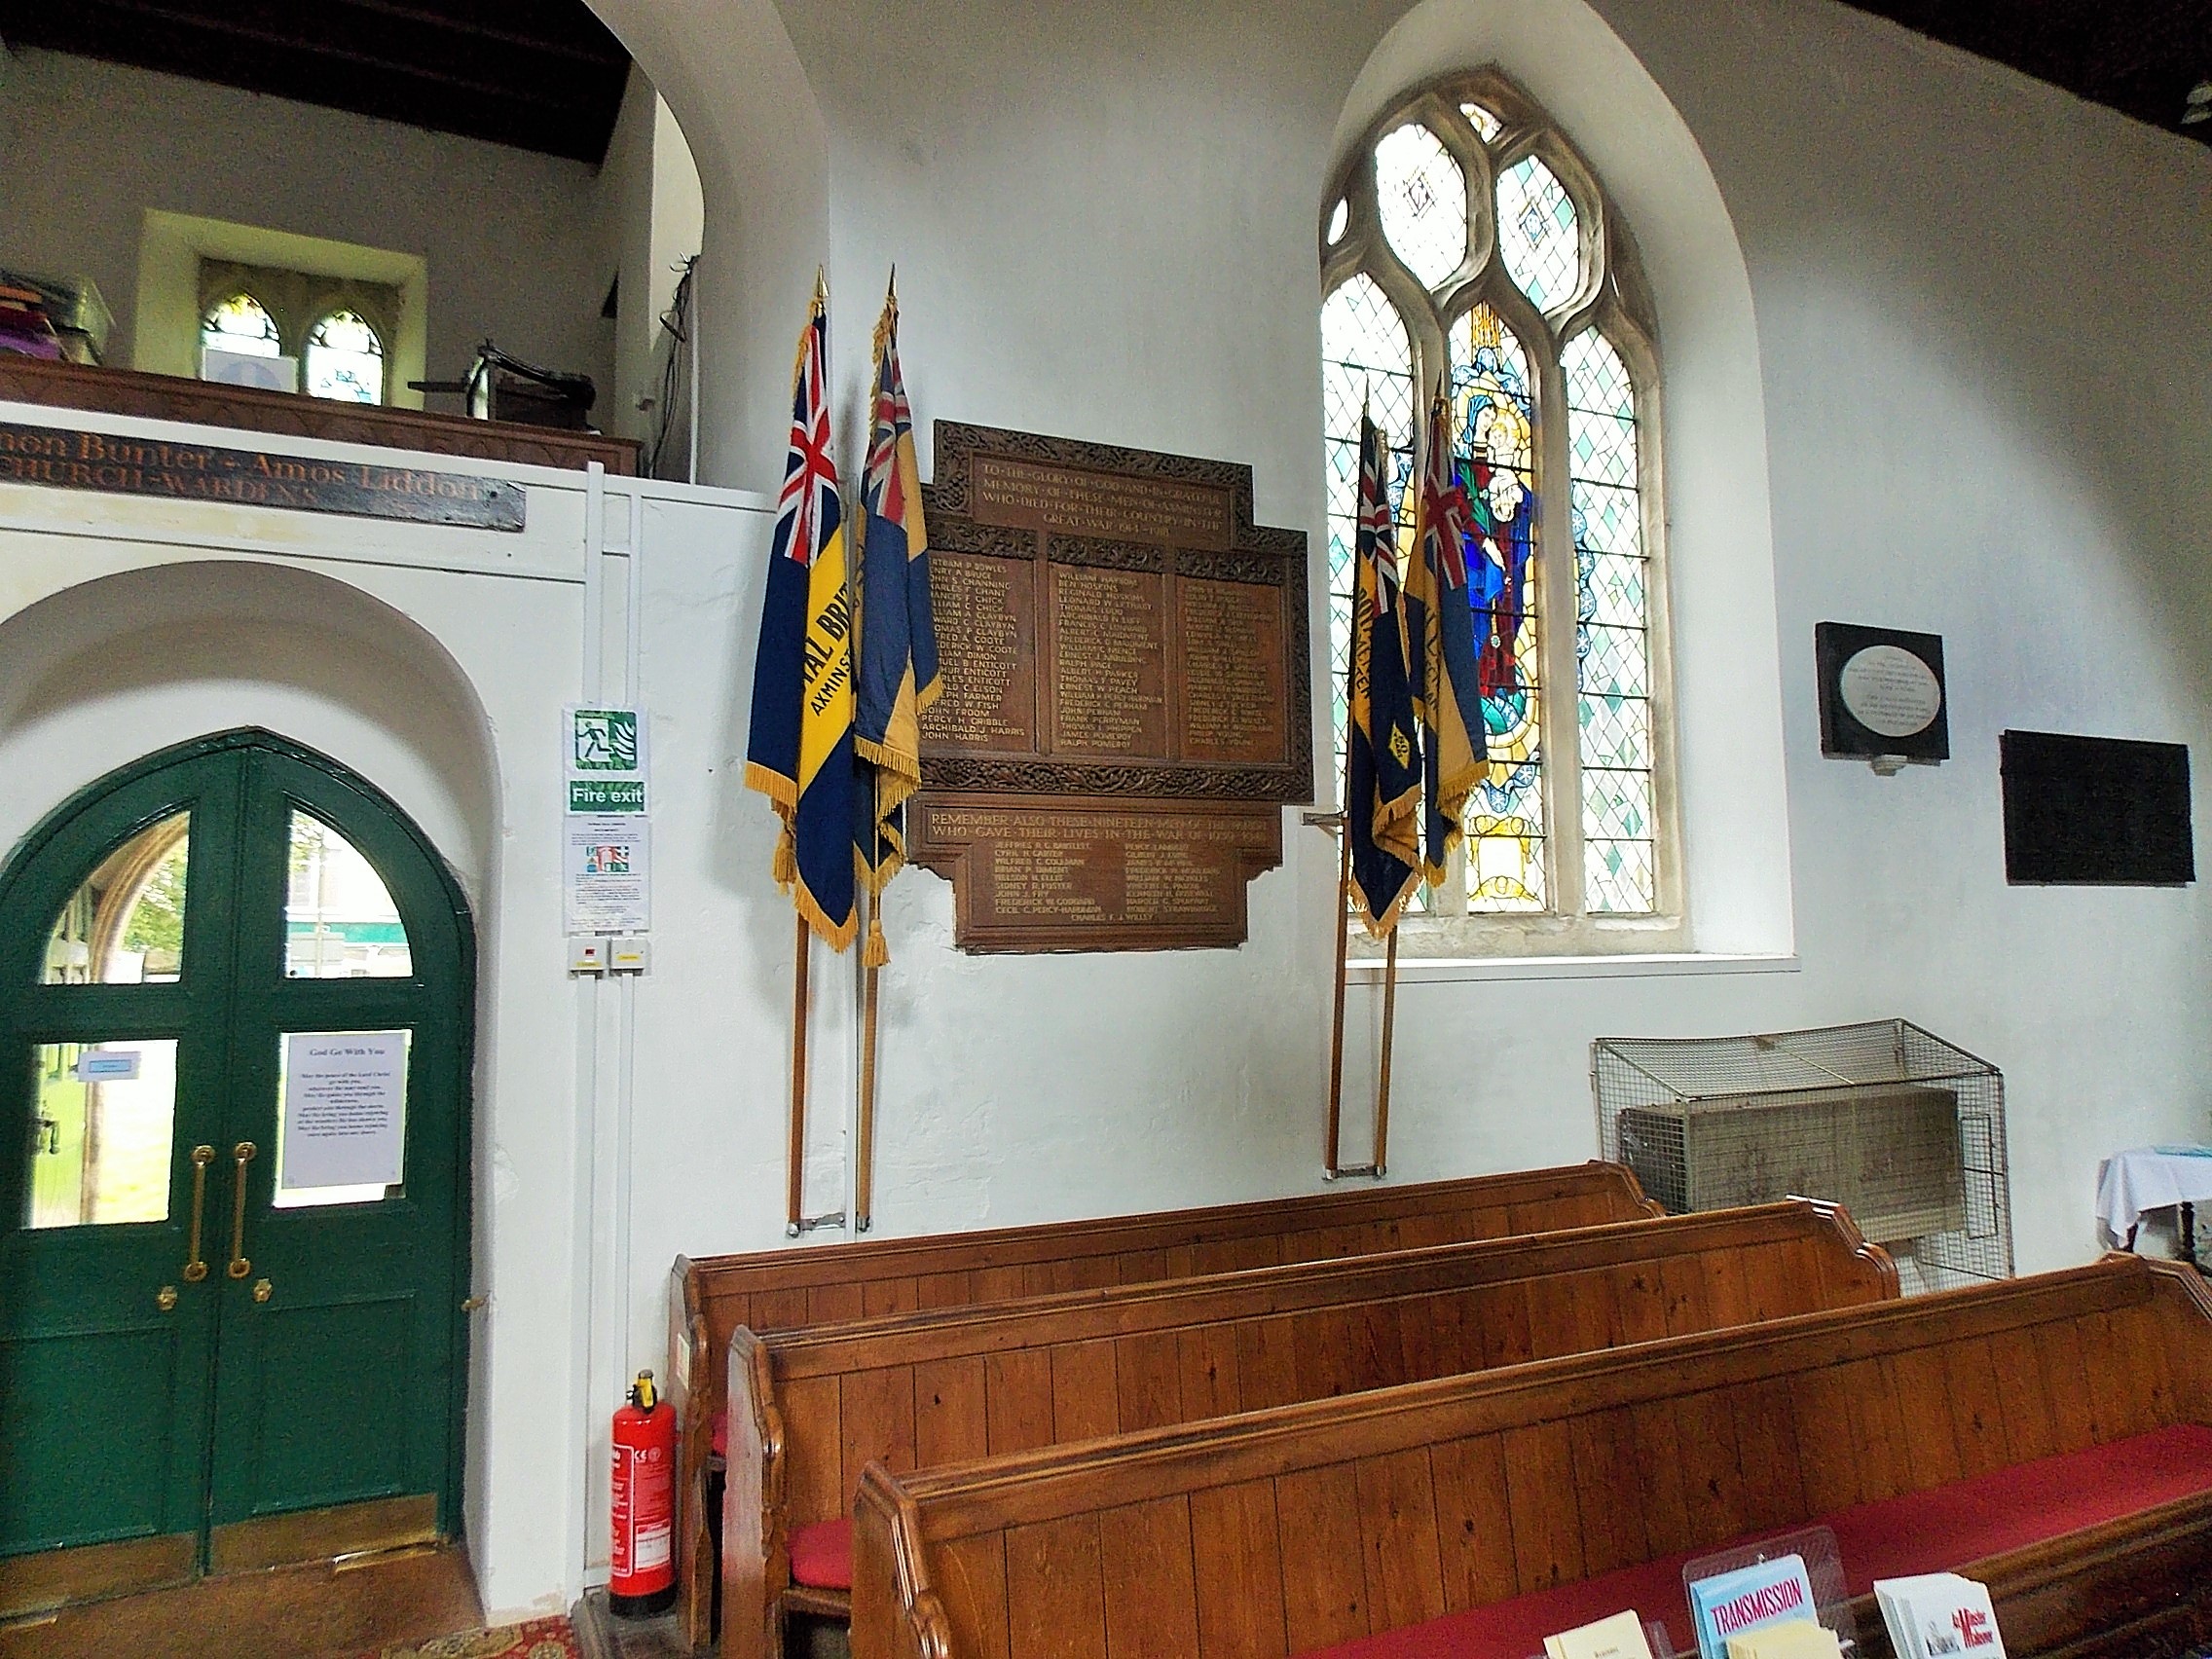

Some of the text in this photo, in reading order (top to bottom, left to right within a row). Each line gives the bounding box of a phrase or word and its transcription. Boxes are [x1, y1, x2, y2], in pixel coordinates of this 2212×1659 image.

[253, 454, 346, 484] Amos
[982, 464, 999, 475] TO
[1032, 471, 1068, 484] GLORY
[983, 478, 1039, 495] MEMORY
[982, 491, 1014, 504] WHO
[1021, 497, 1049, 509] DIED
[1044, 514, 1080, 526] GREAT
[930, 567, 952, 575] NRY
[963, 577, 1012, 590] CHANNING
[931, 584, 962, 593] ARLES
[975, 587, 1006, 597] CHANT
[976, 604, 1005, 612] CHICK
[935, 624, 962, 634] OMAS
[975, 636, 1005, 645] COOTE
[974, 660, 1017, 670] ENTICOTT
[963, 668, 1007, 678] ENTICOTT
[968, 677, 1011, 686] ENTICOTT
[964, 692, 1002, 702] FARMER
[955, 708, 990, 718] FROOM
[922, 715, 952, 723] PERCY
[971, 718, 1009, 727] GRIBBLE
[922, 723, 977, 733] ARCHIBALD
[991, 726, 1025, 736] HARRIS
[922, 731, 949, 740] JOHN
[572, 788, 644, 803] Fire exit
[932, 814, 1009, 826] REMEMBER
[1014, 815, 1045, 827] ALSO
[1050, 816, 1088, 827] THESE
[933, 826, 967, 836] WHO
[976, 827, 1013, 837] GAVE
[1019, 828, 1057, 838] THEIR
[1063, 829, 1099, 839] LIVES
[1710, 1577, 1804, 1637] TRANSMISSION
